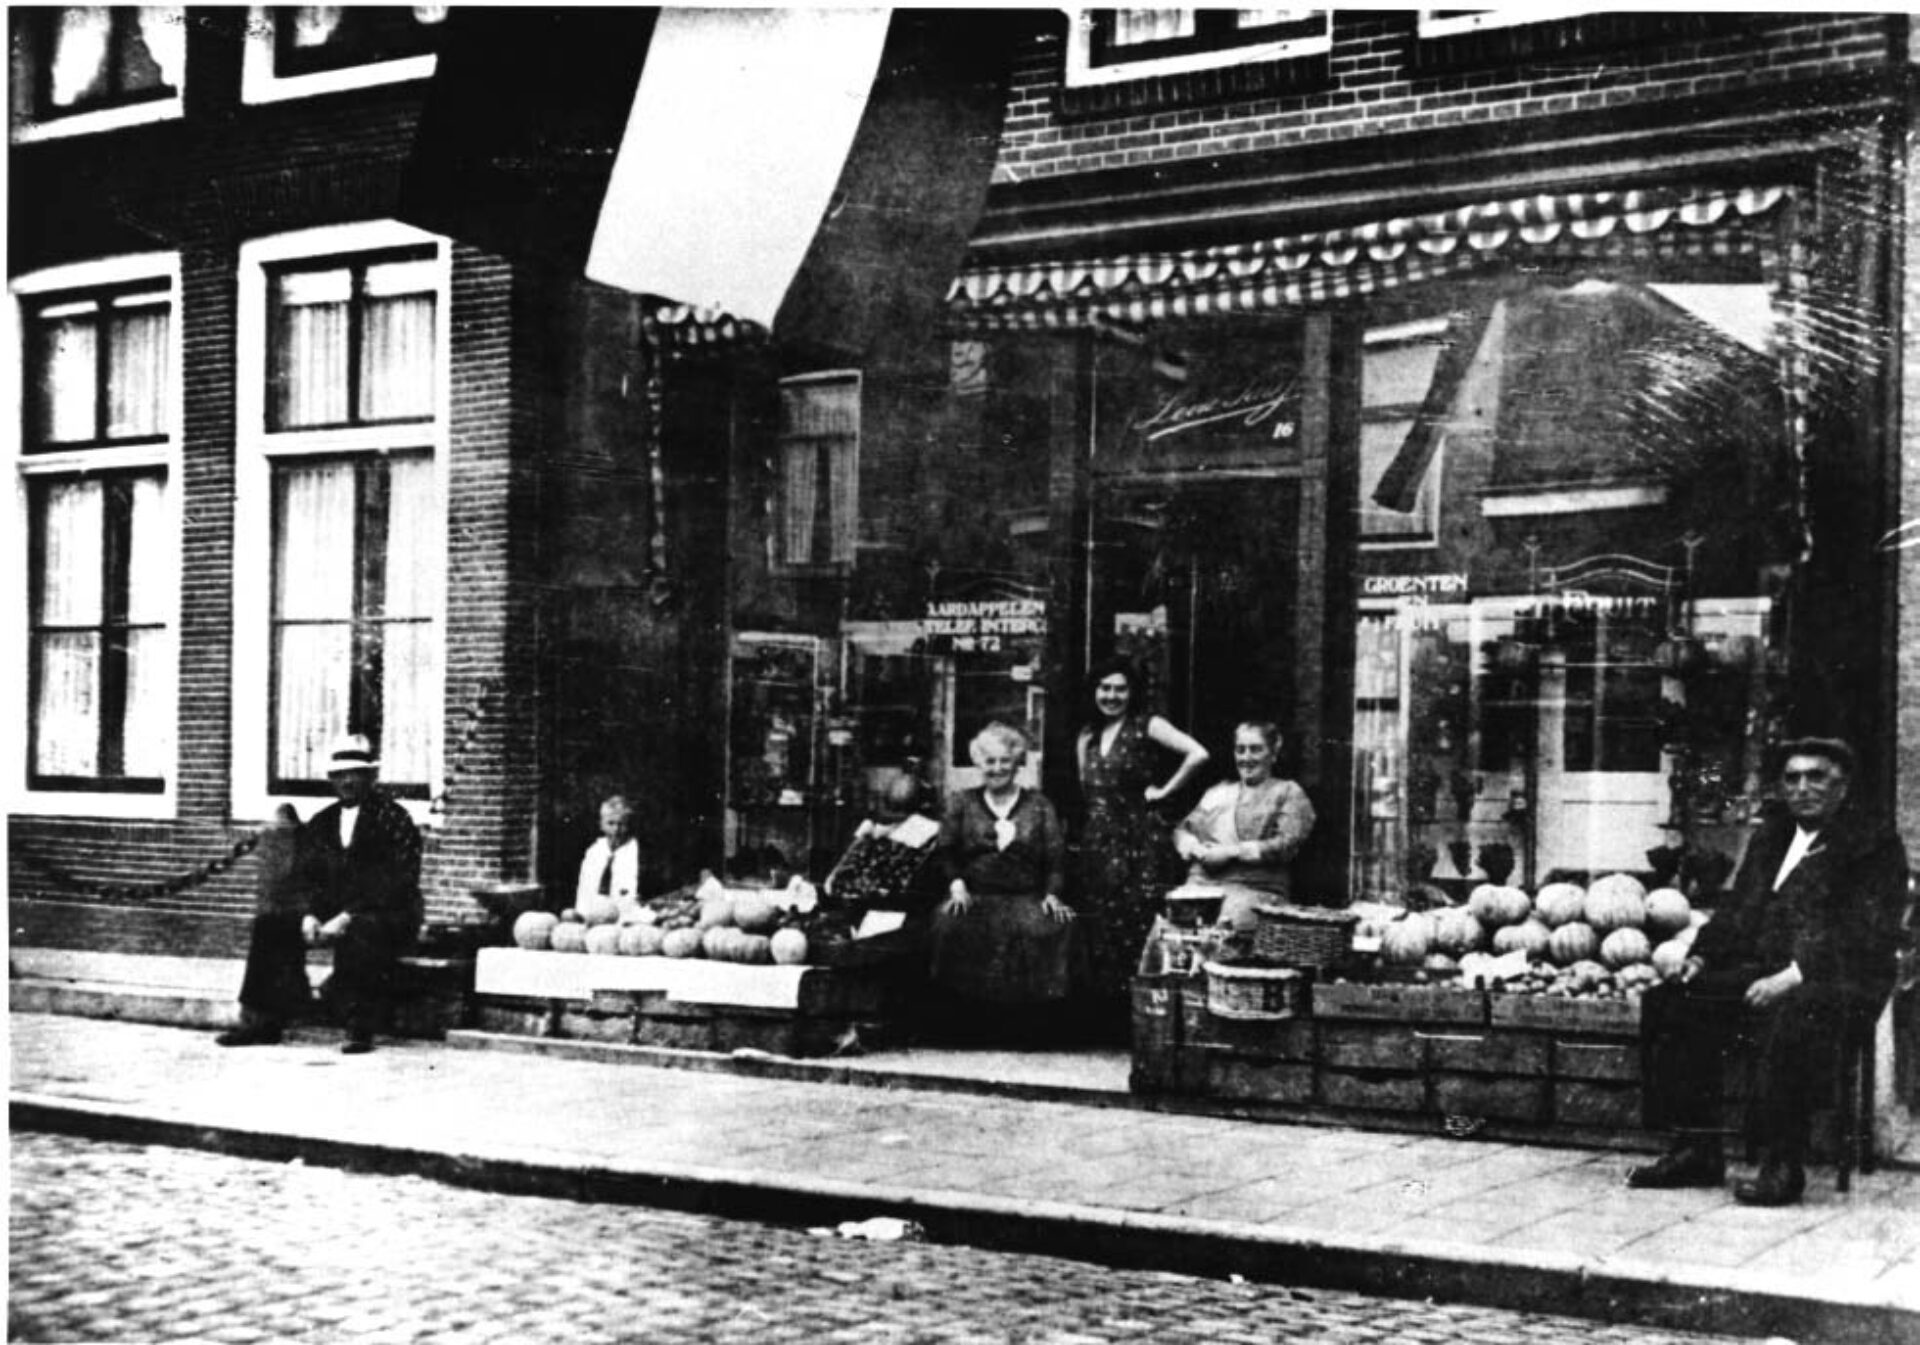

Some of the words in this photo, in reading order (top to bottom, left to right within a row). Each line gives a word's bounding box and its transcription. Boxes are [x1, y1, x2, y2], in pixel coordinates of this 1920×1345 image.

[1272, 422, 1295, 439] 16
[1364, 573, 1468, 593] GROENTEN
[927, 600, 1046, 617] AARDAPPELEN
[981, 636, 1001, 651] 72
